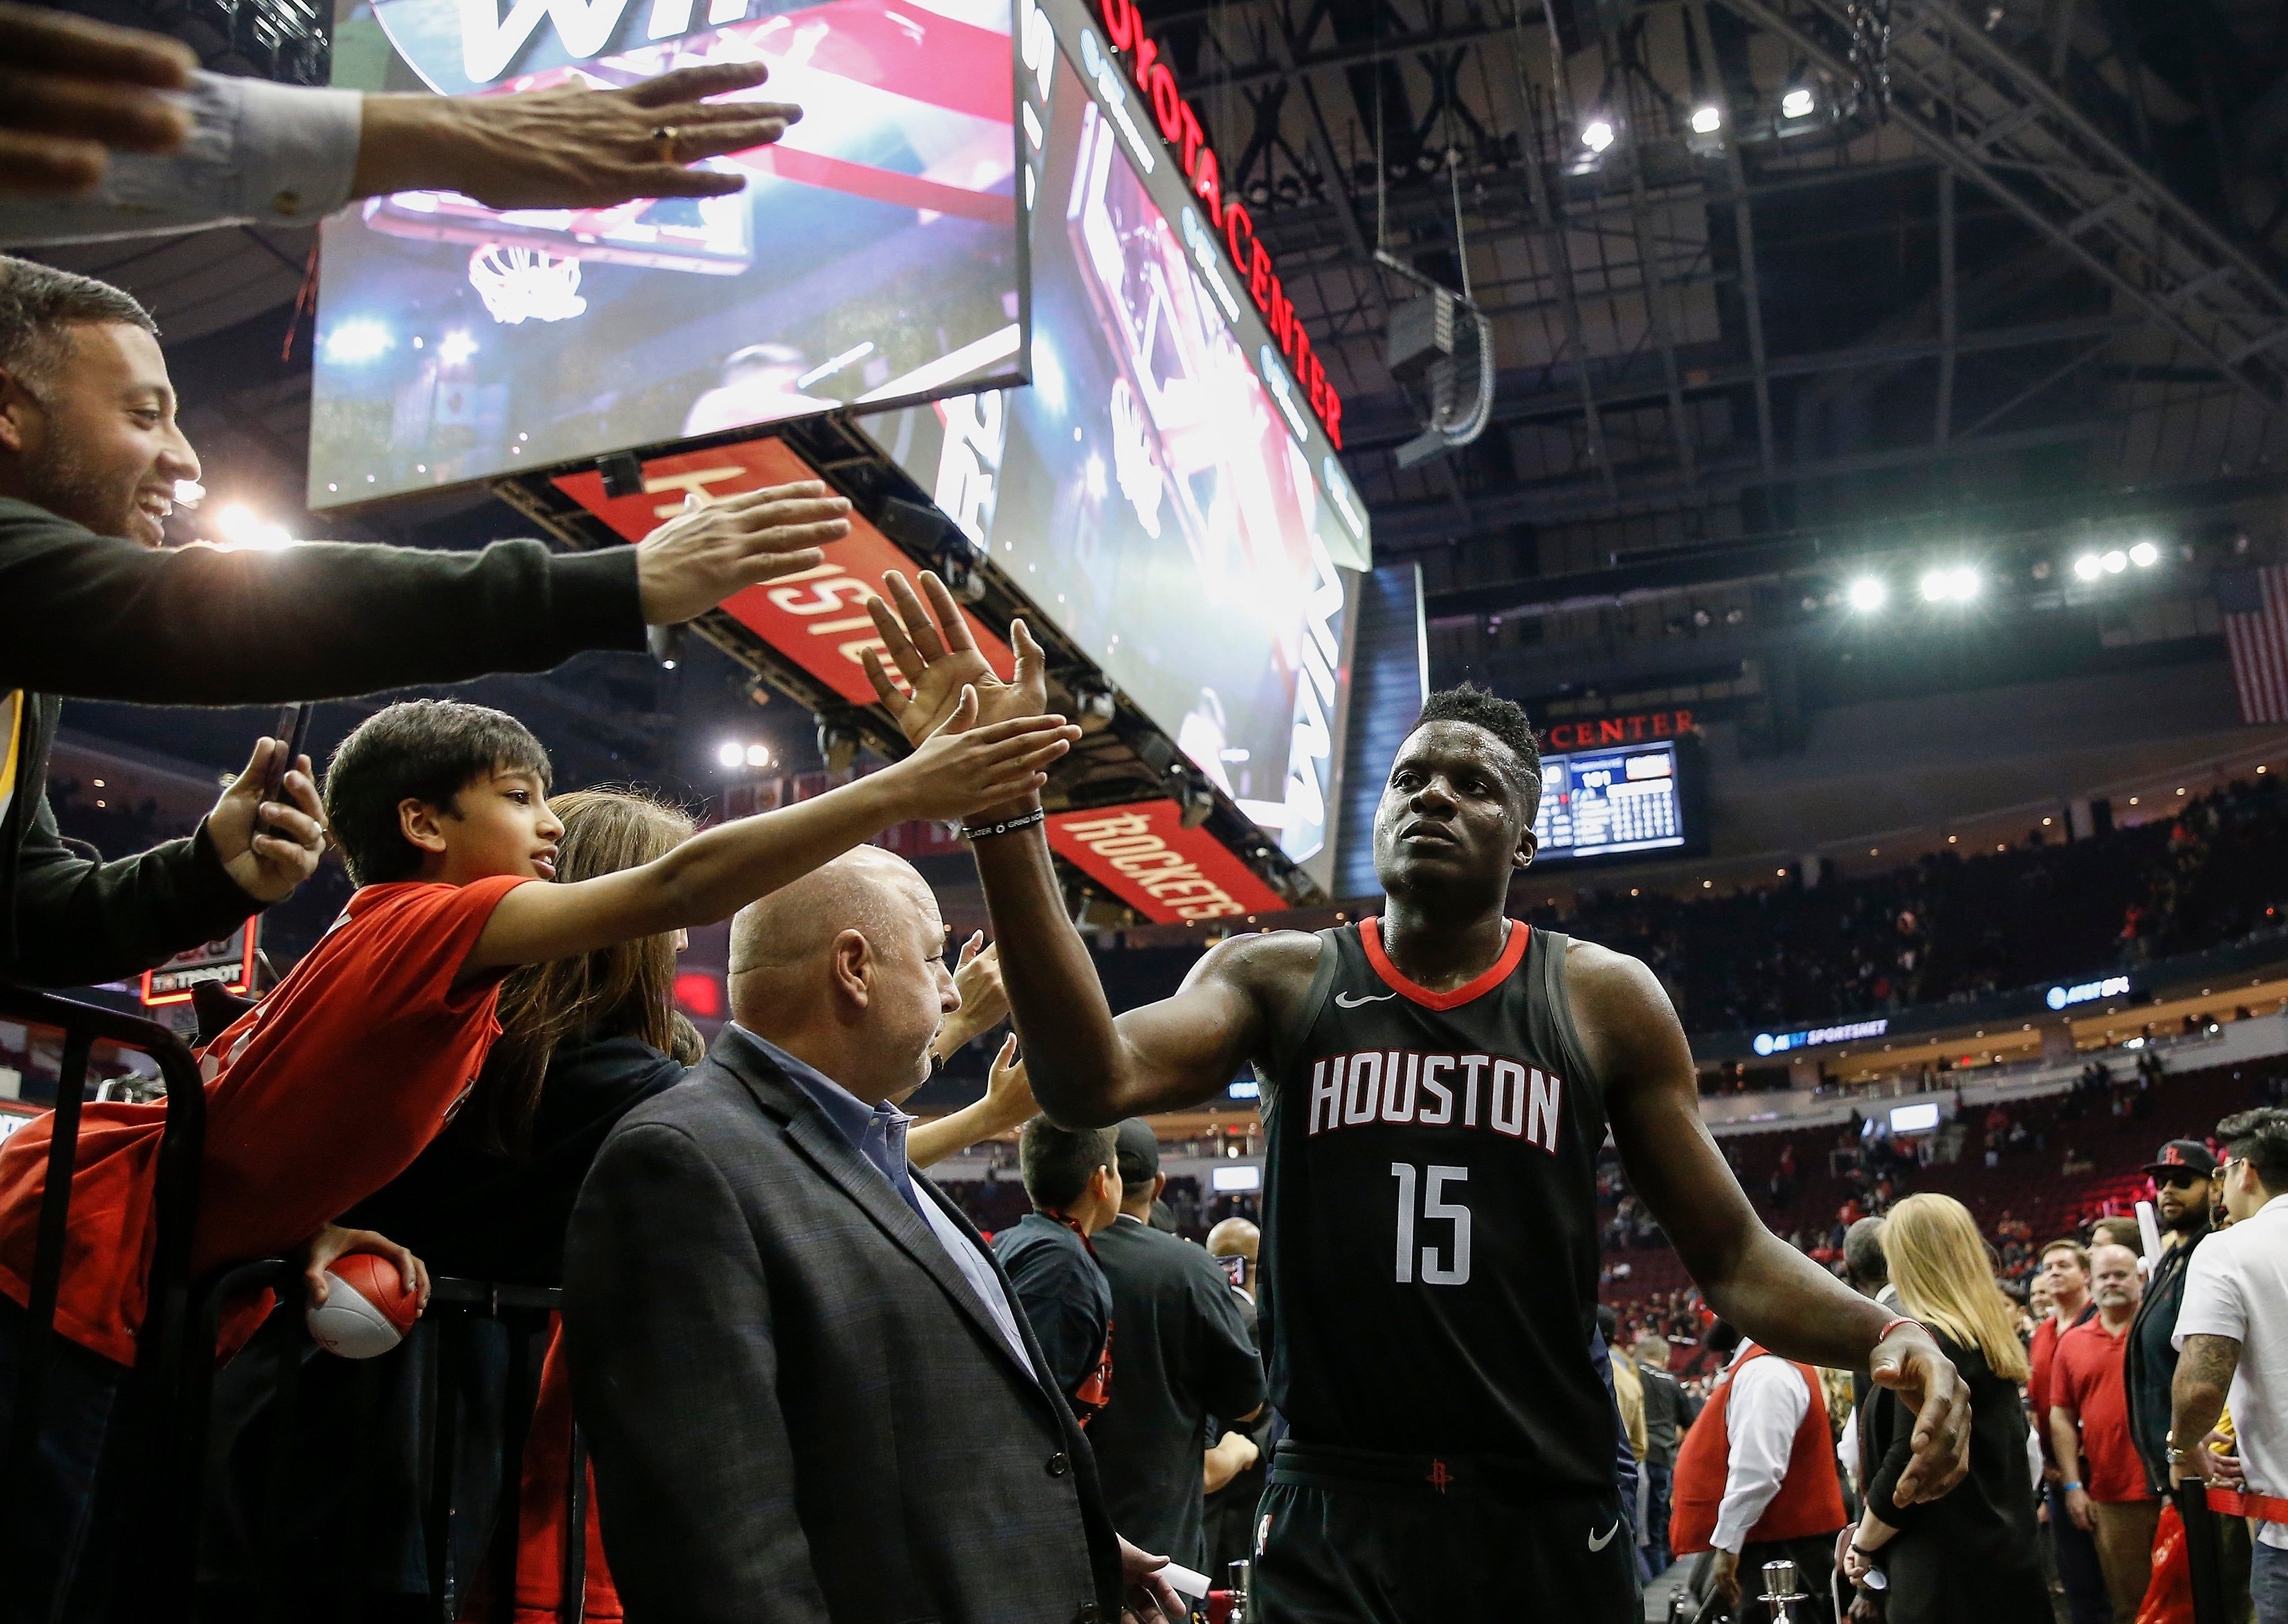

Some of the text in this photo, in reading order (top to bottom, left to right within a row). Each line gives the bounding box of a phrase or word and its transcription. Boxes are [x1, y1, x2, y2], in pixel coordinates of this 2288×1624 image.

[1100, 0, 1222, 227] OYOTA
[1227, 203, 1343, 450] CENTER
[1549, 709, 1694, 749] CENTER
[1061, 812, 1246, 919] ROCKETS
[1308, 1048, 1563, 1156] HOUSTON
[1391, 1162, 1471, 1286] 15
